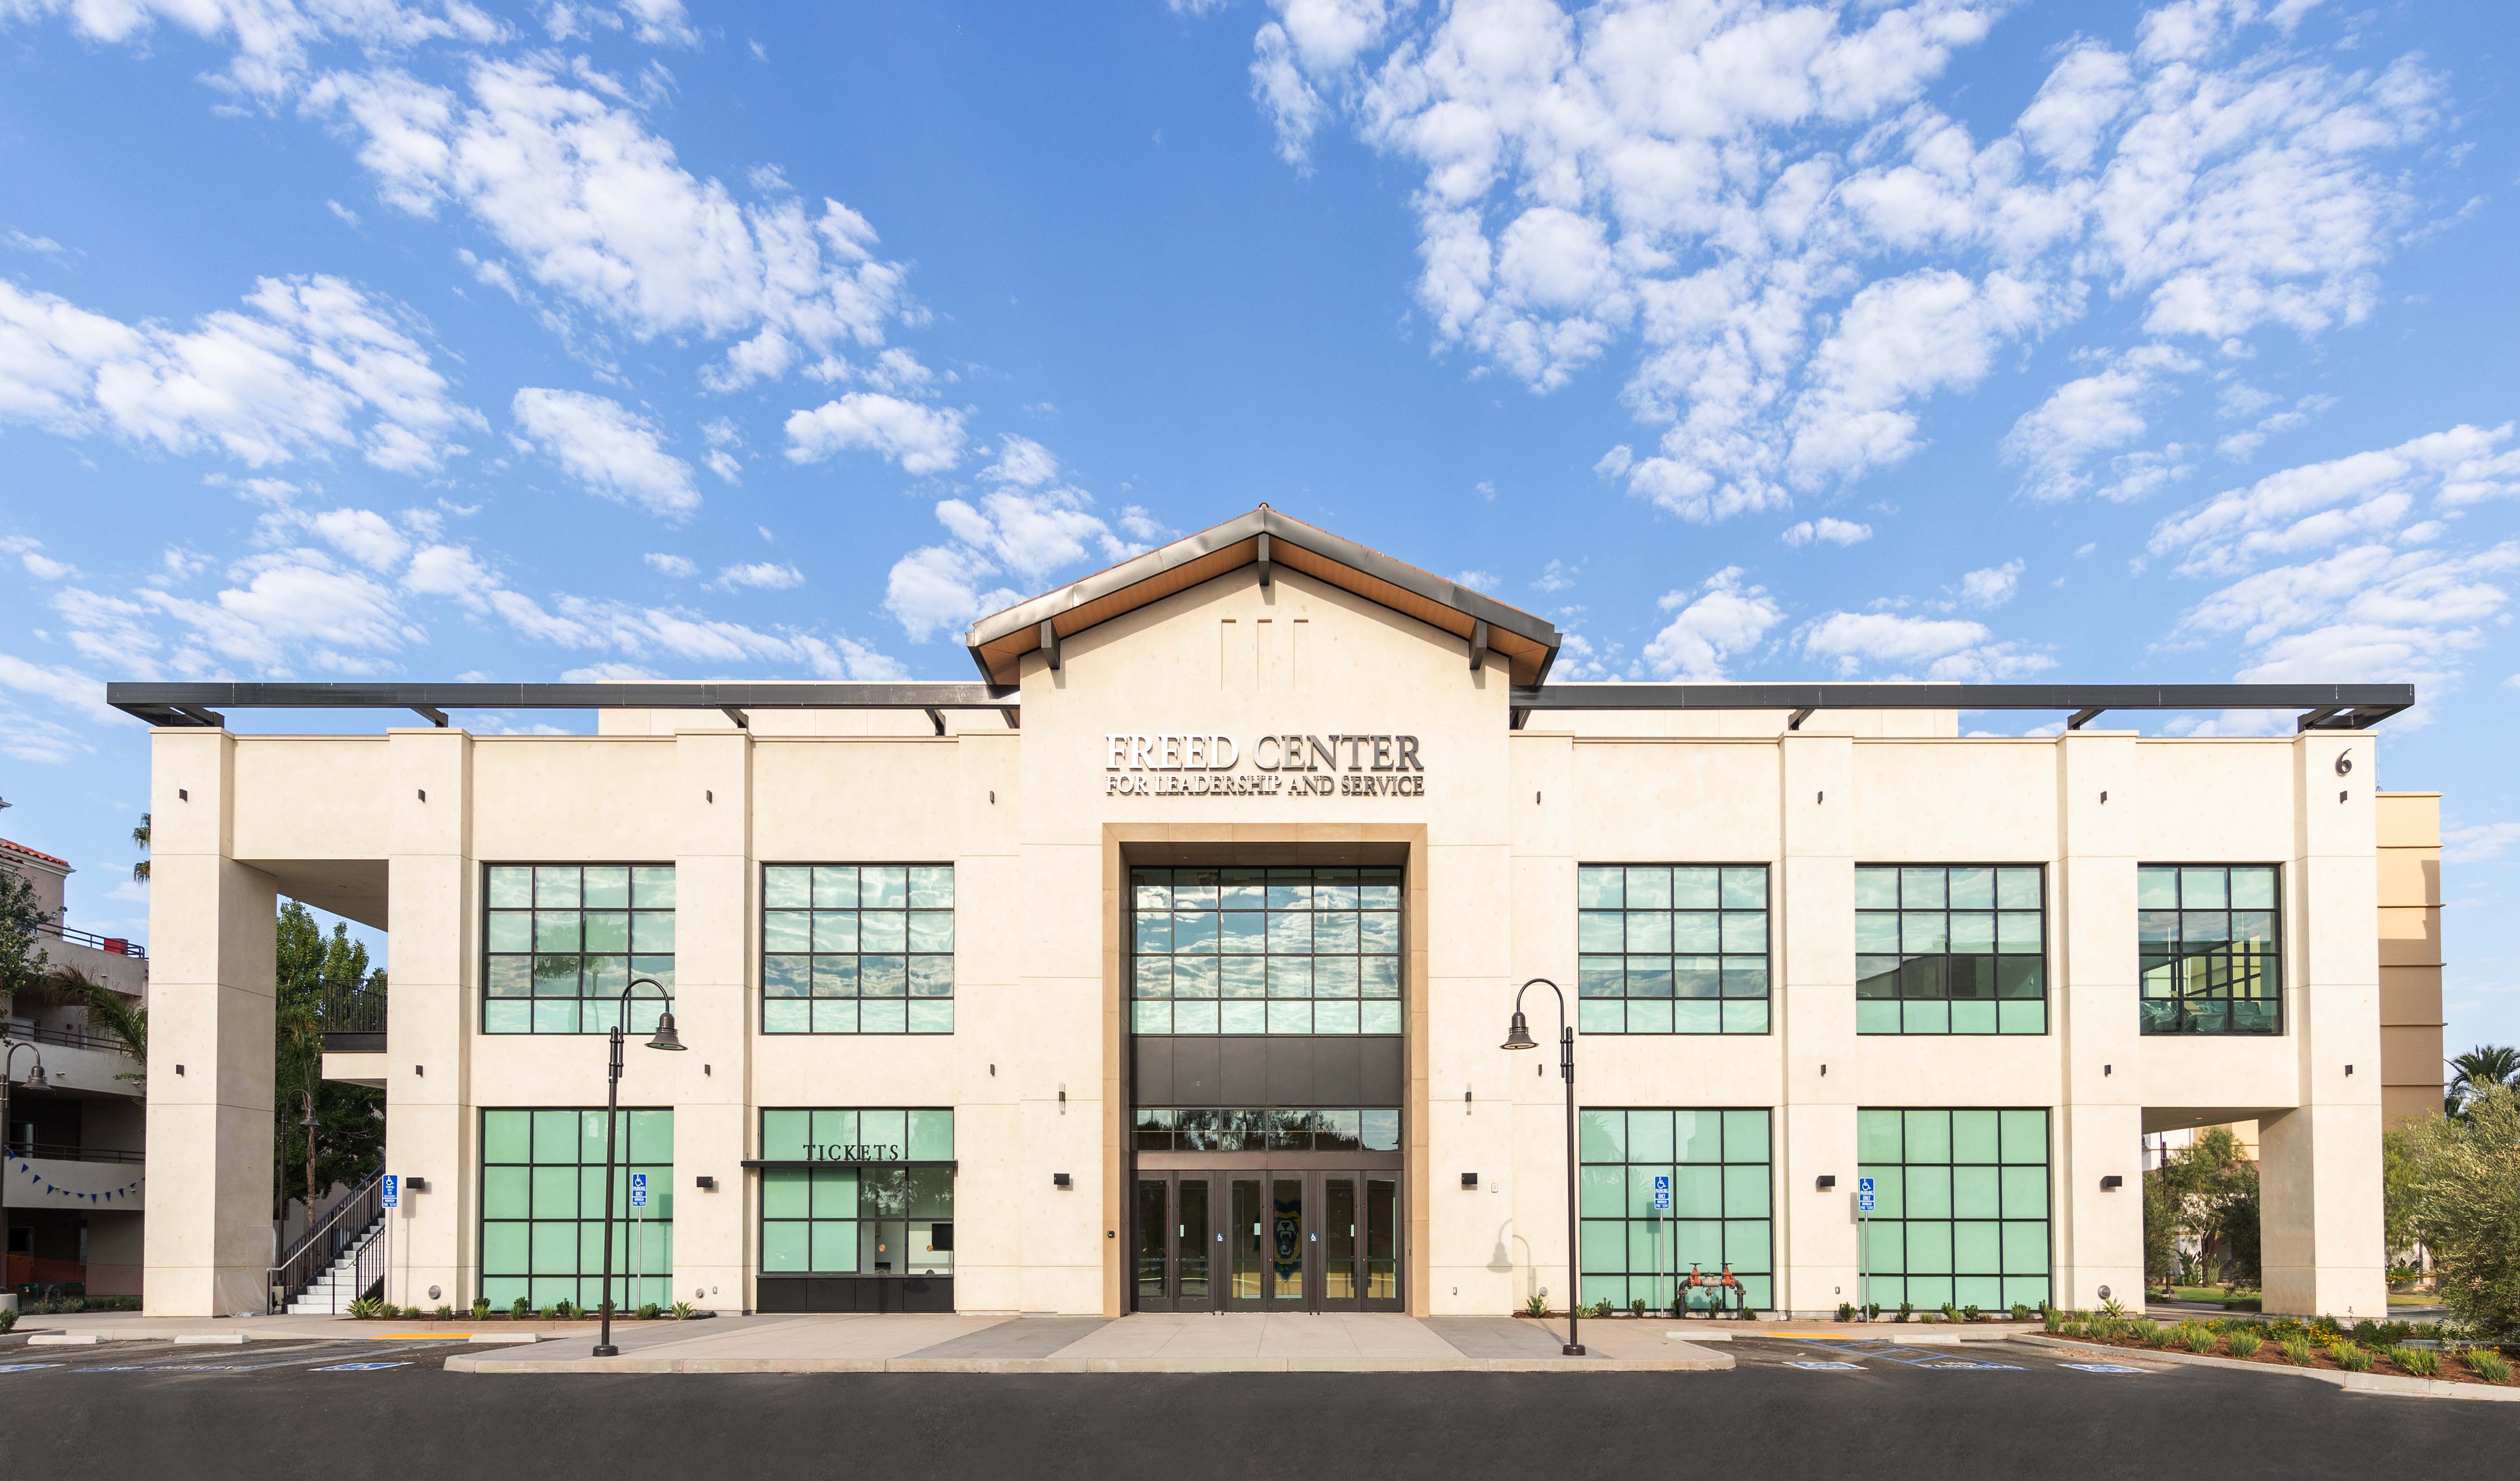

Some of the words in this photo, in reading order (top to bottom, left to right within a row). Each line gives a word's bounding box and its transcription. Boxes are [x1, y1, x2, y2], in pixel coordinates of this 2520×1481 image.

[1106, 734, 1239, 770] FREED
[1252, 734, 1424, 771] CENTER
[2335, 748, 2352, 775] 6
[1106, 775, 1149, 794] FOR
[1154, 775, 1282, 795] LEADERSHIP
[1288, 775, 1334, 795] AND
[1341, 775, 1424, 796] SERVICE
[803, 1145, 898, 1160] TICKETS
